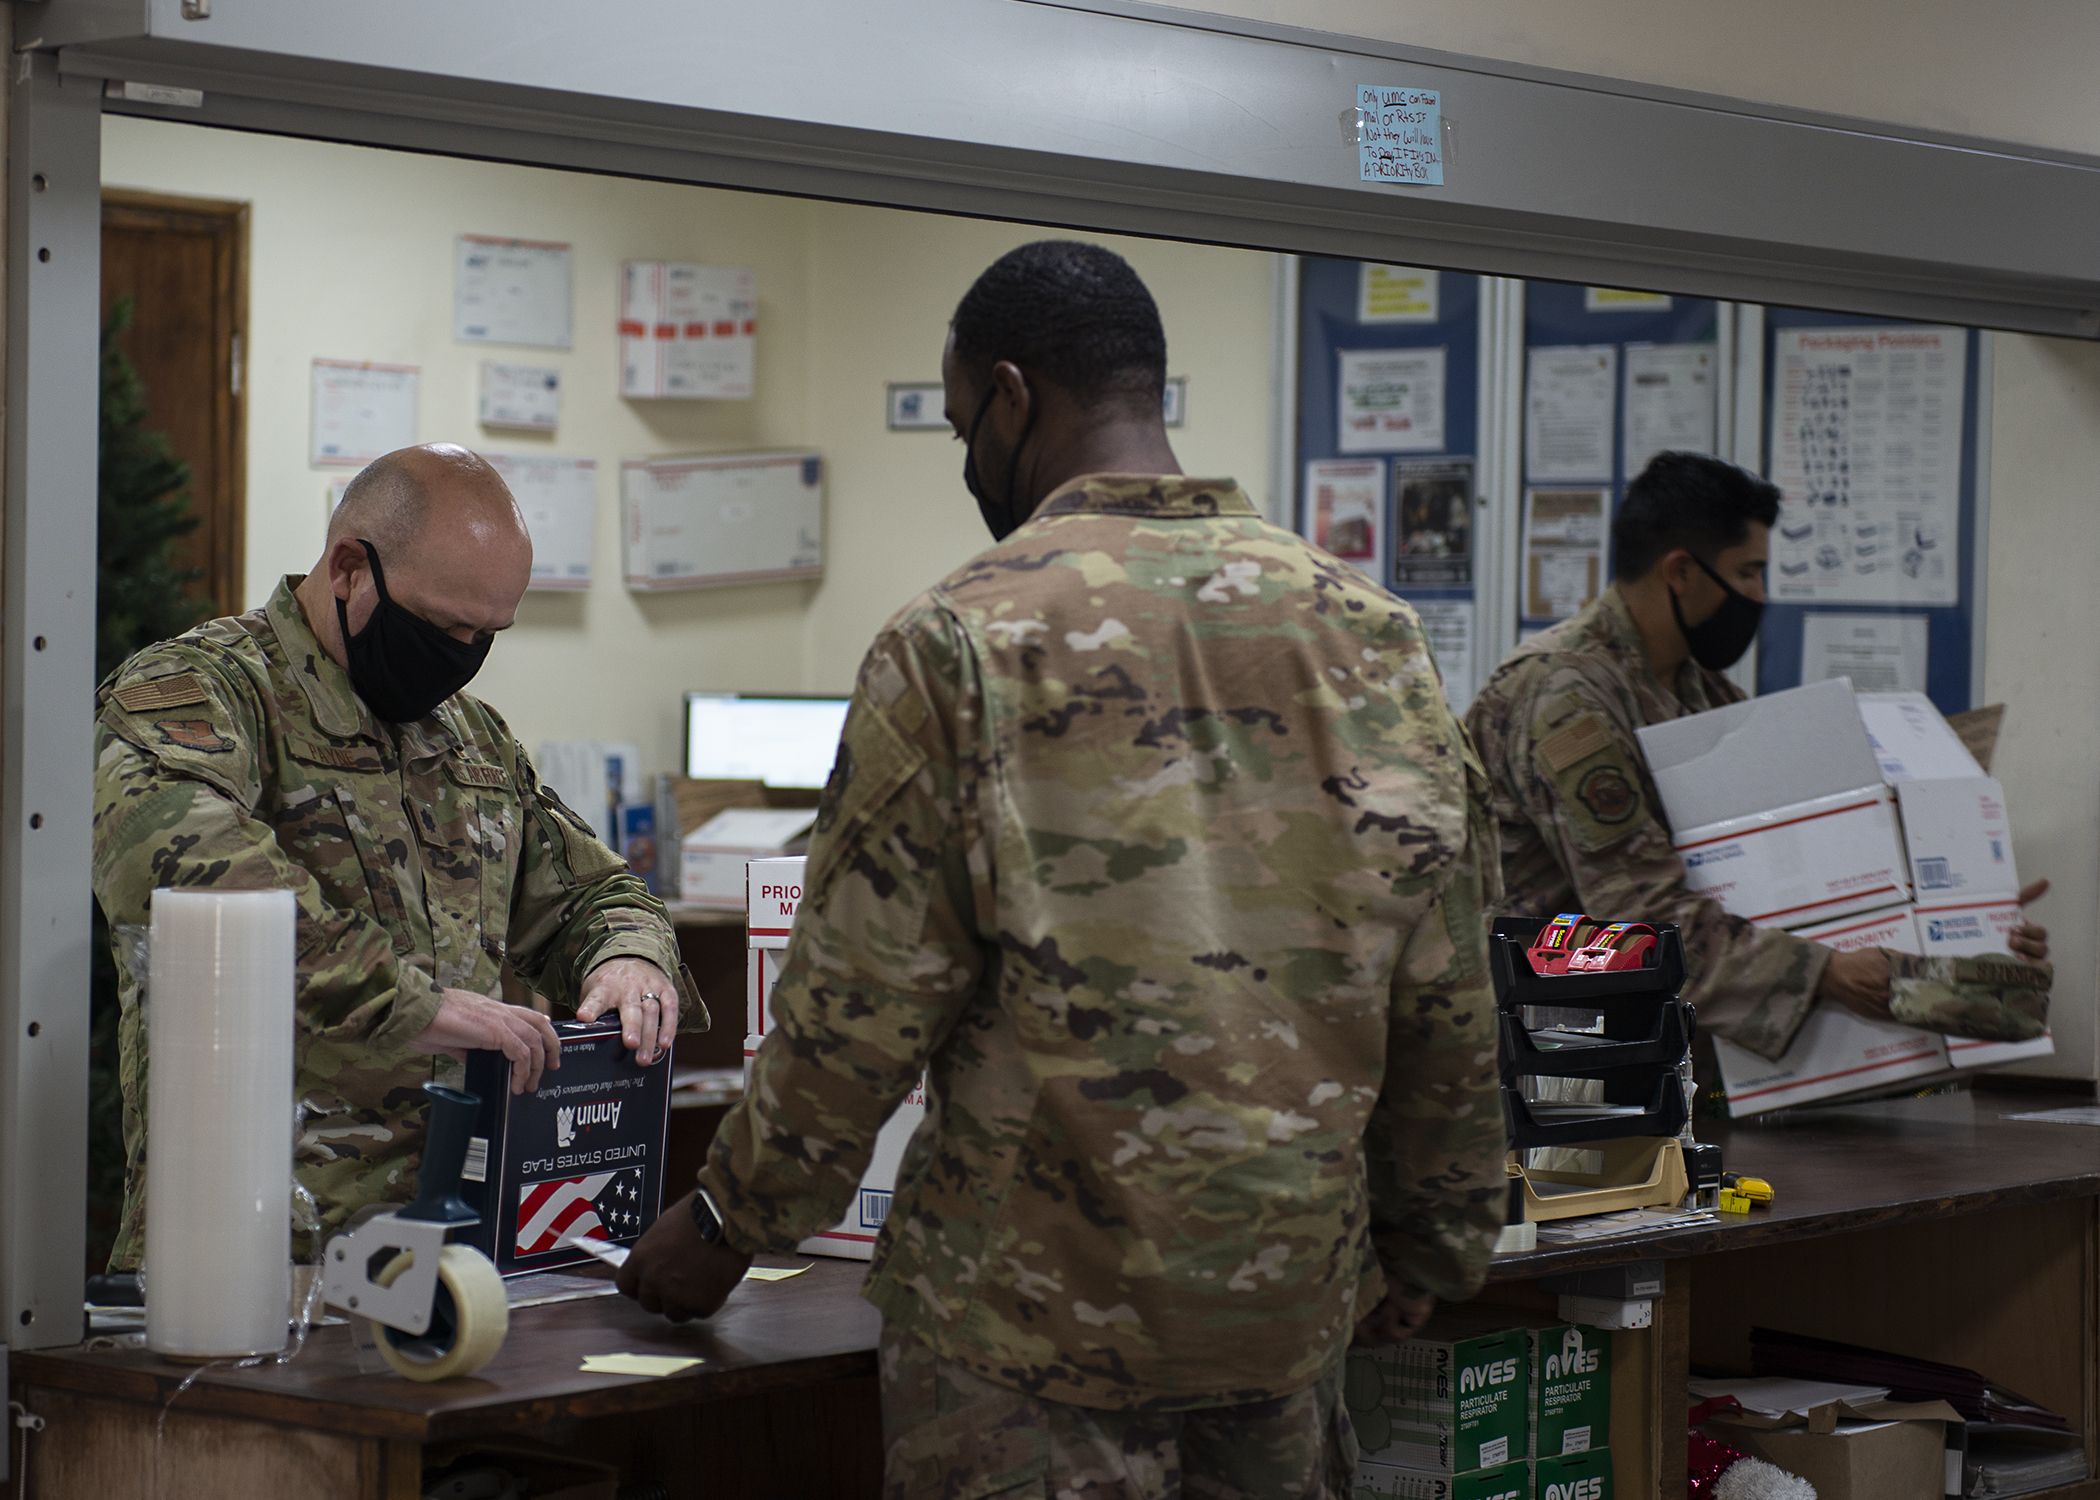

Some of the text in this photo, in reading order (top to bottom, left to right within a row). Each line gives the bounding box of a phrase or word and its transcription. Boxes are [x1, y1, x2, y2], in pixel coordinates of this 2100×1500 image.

[1364, 162, 1371, 176] A
[307, 742, 358, 768] PAYNE
[762, 885, 801, 900] PRIO
[563, 1043, 595, 1053] Made in the
[562, 1082, 599, 1094] Guarantees
[613, 1078, 631, 1089] Name
[632, 1075, 646, 1088] The
[904, 1094, 924, 1106] MA
[577, 1101, 622, 1132] Annin
[522, 1143, 646, 1174] UNITED STATES FLAG
[1460, 1358, 1516, 1394] AVES
[1545, 1380, 1591, 1397] PARTICULATE
[1460, 1390, 1508, 1411] PARTICULATE
[1545, 1392, 1582, 1406] RESPIRATOR
[1460, 1403, 1498, 1420] RESPIRATOR
